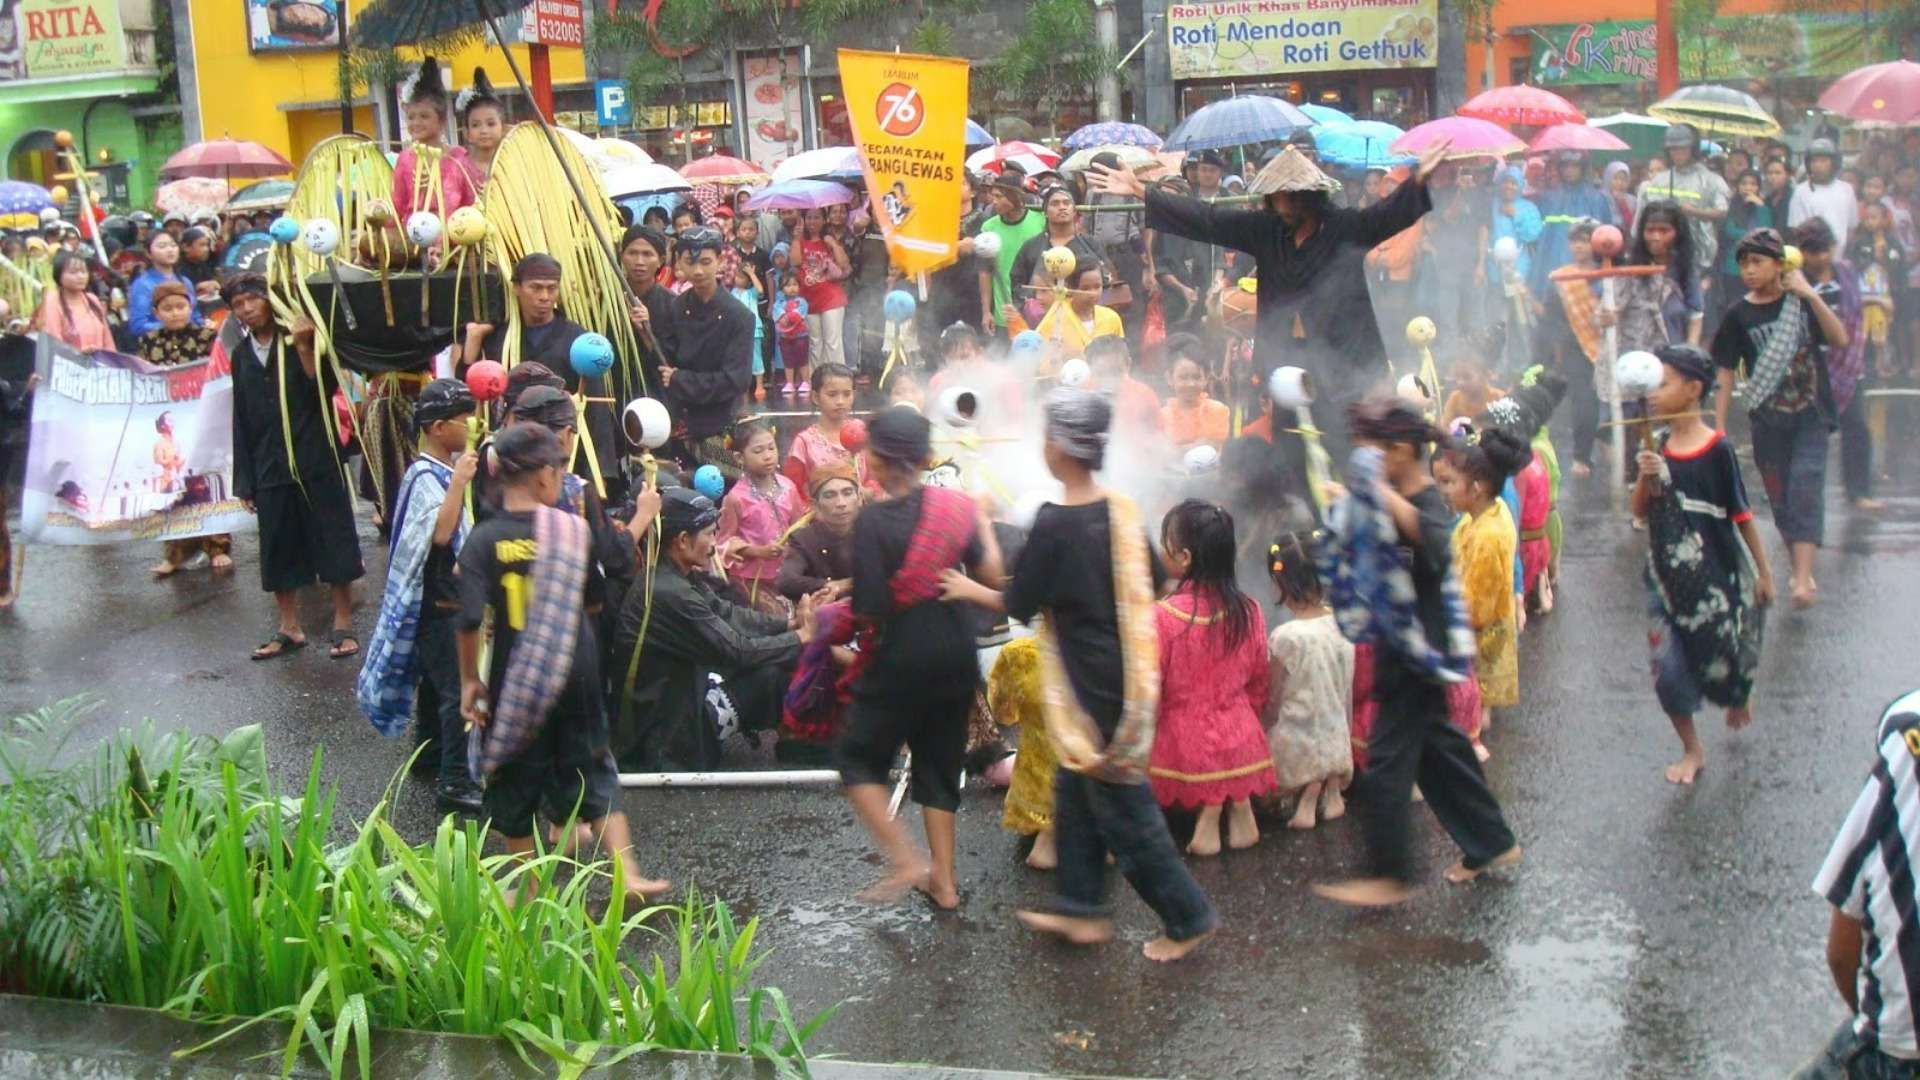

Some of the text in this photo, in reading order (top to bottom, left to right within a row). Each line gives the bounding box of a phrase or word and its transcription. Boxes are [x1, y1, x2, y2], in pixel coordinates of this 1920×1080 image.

[1172, 7, 1207, 18] Roti
[1214, 3, 1251, 16] Unik
[1258, 0, 1300, 12] Khas
[25, 5, 105, 42] RITA
[540, 19, 581, 43] 632005
[1173, 18, 1341, 45] Roti Mendoan
[1284, 38, 1426, 63] Roti Gethuk
[602, 86, 625, 119] P
[879, 88, 917, 131] 76
[863, 143, 945, 161] ECAMATAN
